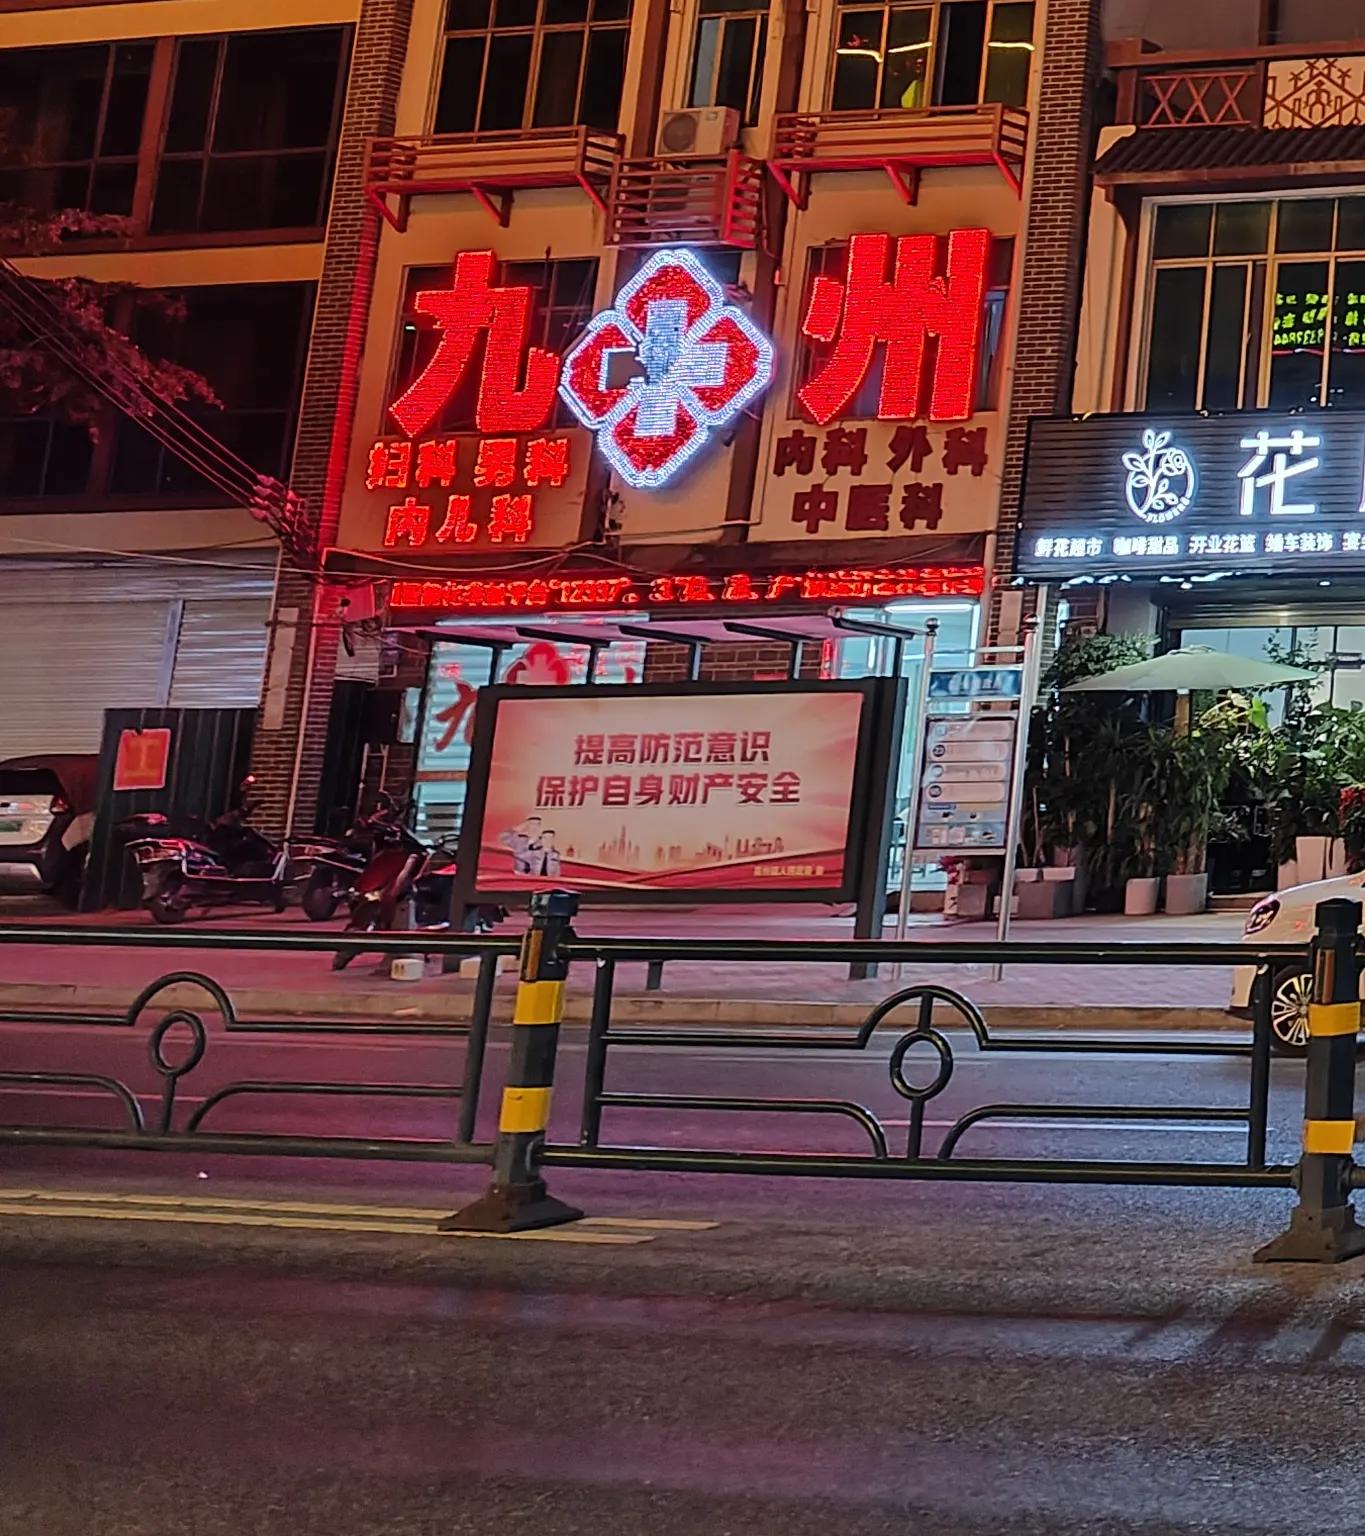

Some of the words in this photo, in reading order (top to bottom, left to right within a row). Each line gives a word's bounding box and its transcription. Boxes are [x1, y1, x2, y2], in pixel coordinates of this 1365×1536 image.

[389, 250, 560, 439] 九
[798, 227, 988, 426] 州
[365, 439, 457, 490] 妇科
[473, 438, 569, 488] 男科
[773, 427, 868, 477] 内科
[886, 425, 989, 477] 外科
[384, 494, 533, 547] 内儿科
[791, 482, 944, 534] 中医科
[1034, 536, 1103, 558] 鲜花超市
[1112, 535, 1179, 556] 咖啡甜品
[1188, 533, 1256, 555] 开业花篮
[574, 730, 772, 766] 提高防范意识
[534, 770, 801, 809] 保护自身财产安全
